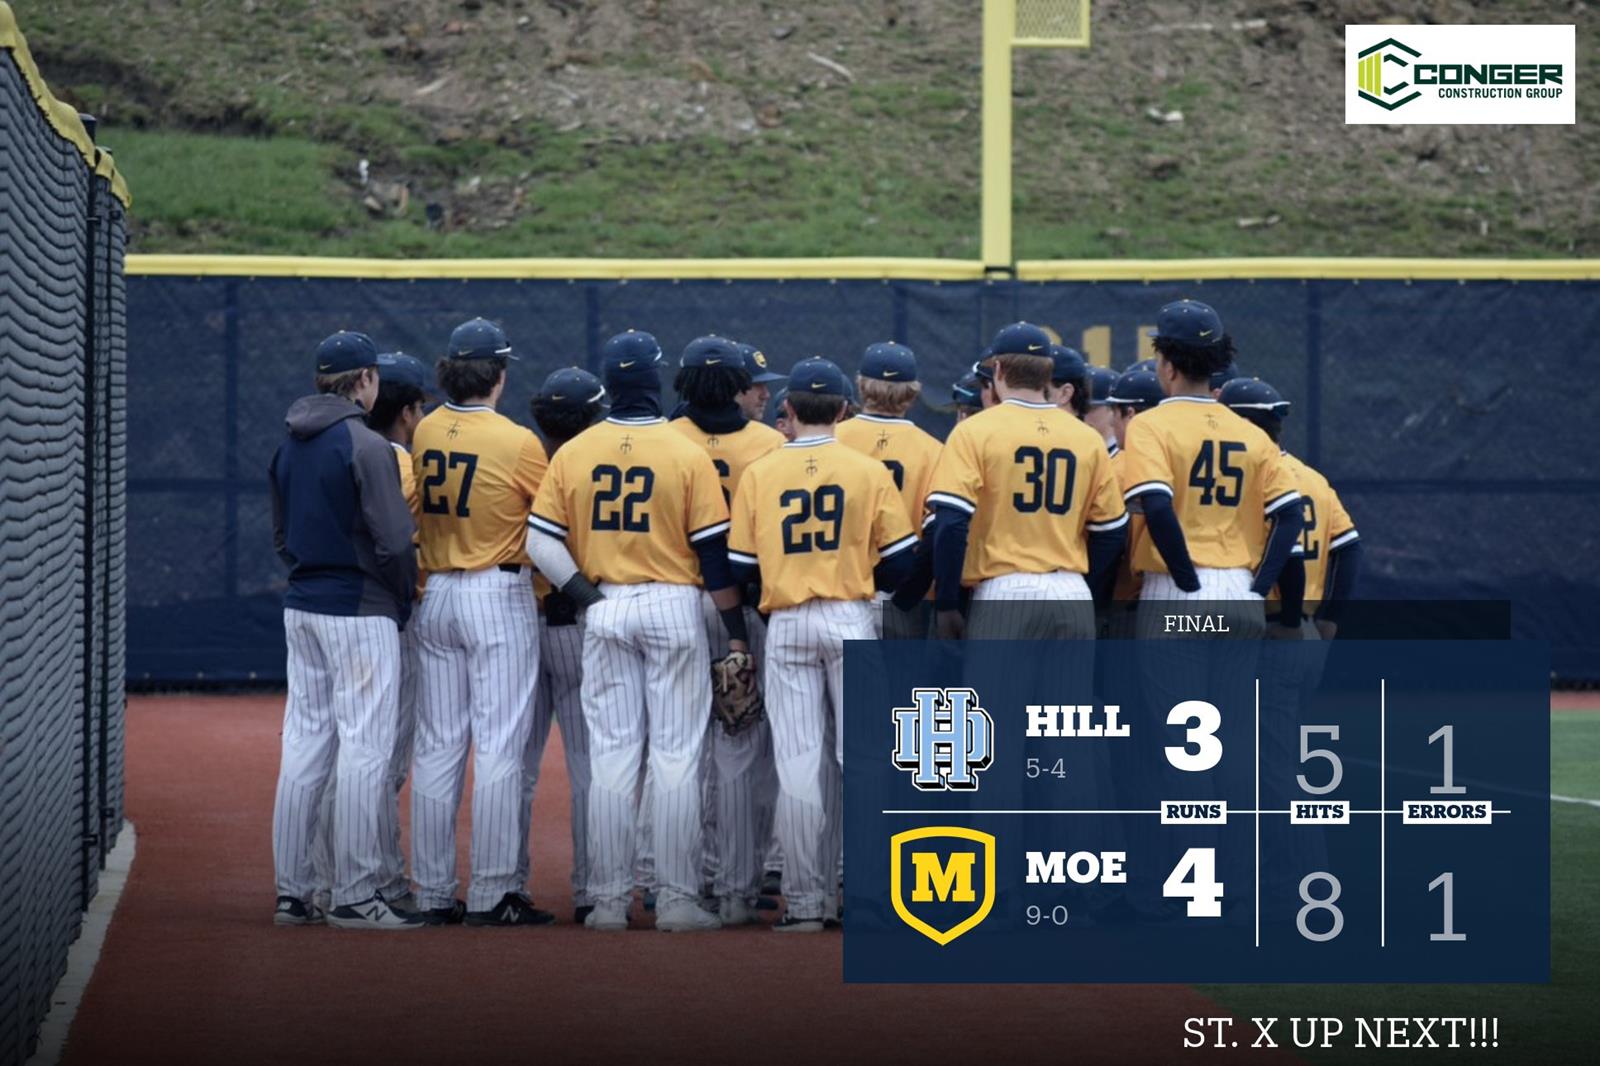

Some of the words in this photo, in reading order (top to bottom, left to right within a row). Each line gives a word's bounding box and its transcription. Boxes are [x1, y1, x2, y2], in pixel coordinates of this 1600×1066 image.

[422, 449, 479, 518] 27
[591, 464, 655, 533] 22
[1012, 446, 1077, 515] 30
[1188, 439, 1247, 508] 45
[779, 484, 845, 555] 29
